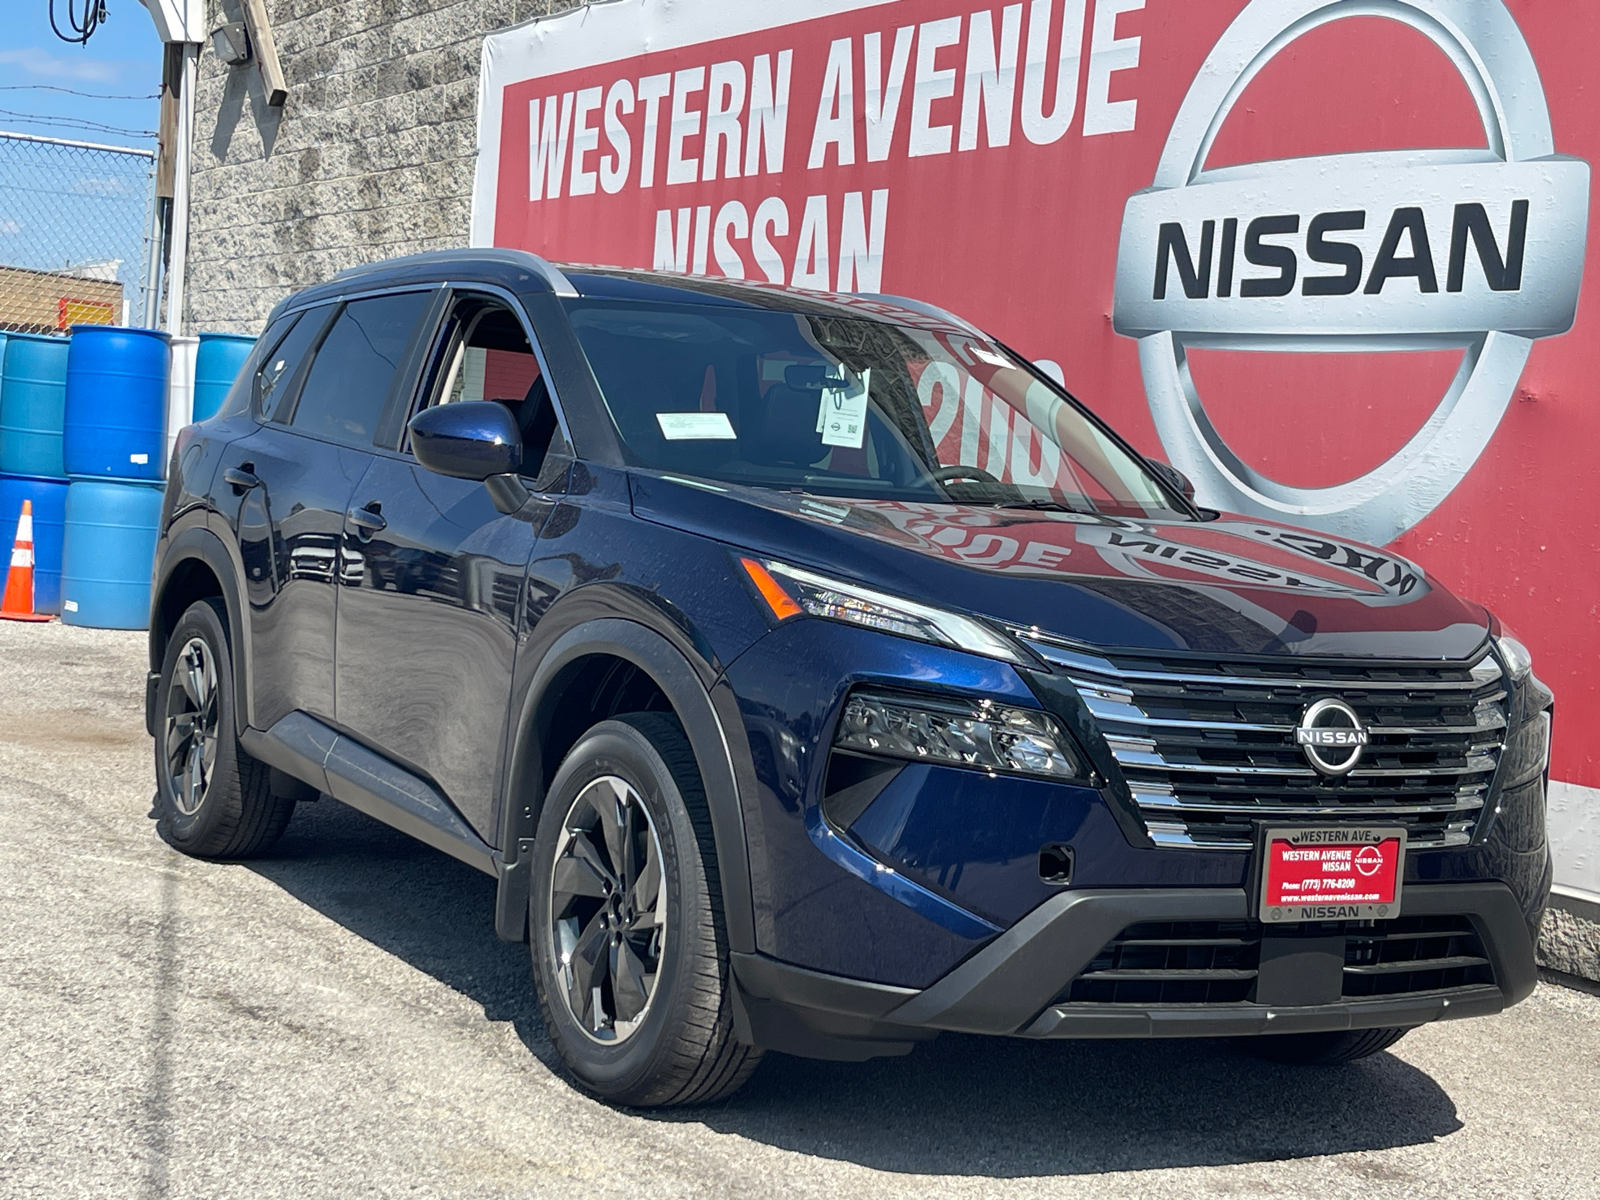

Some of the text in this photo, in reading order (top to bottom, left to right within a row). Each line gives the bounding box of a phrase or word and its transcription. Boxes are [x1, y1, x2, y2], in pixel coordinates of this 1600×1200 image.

[528, 0, 1146, 202] WESTERN AVENUE
[653, 188, 888, 293] NISSAN
[1153, 199, 1529, 300] NISSAN
[1300, 731, 1367, 744] NISSAN
[1300, 830, 1373, 842] WESTERN AVE.
[1282, 850, 1352, 861] WESTERN AVENUE
[1322, 862, 1351, 872] NISSAN
[1281, 879, 1355, 891] Phone: (773) 776-8200
[1301, 906, 1359, 918] NISSAN
